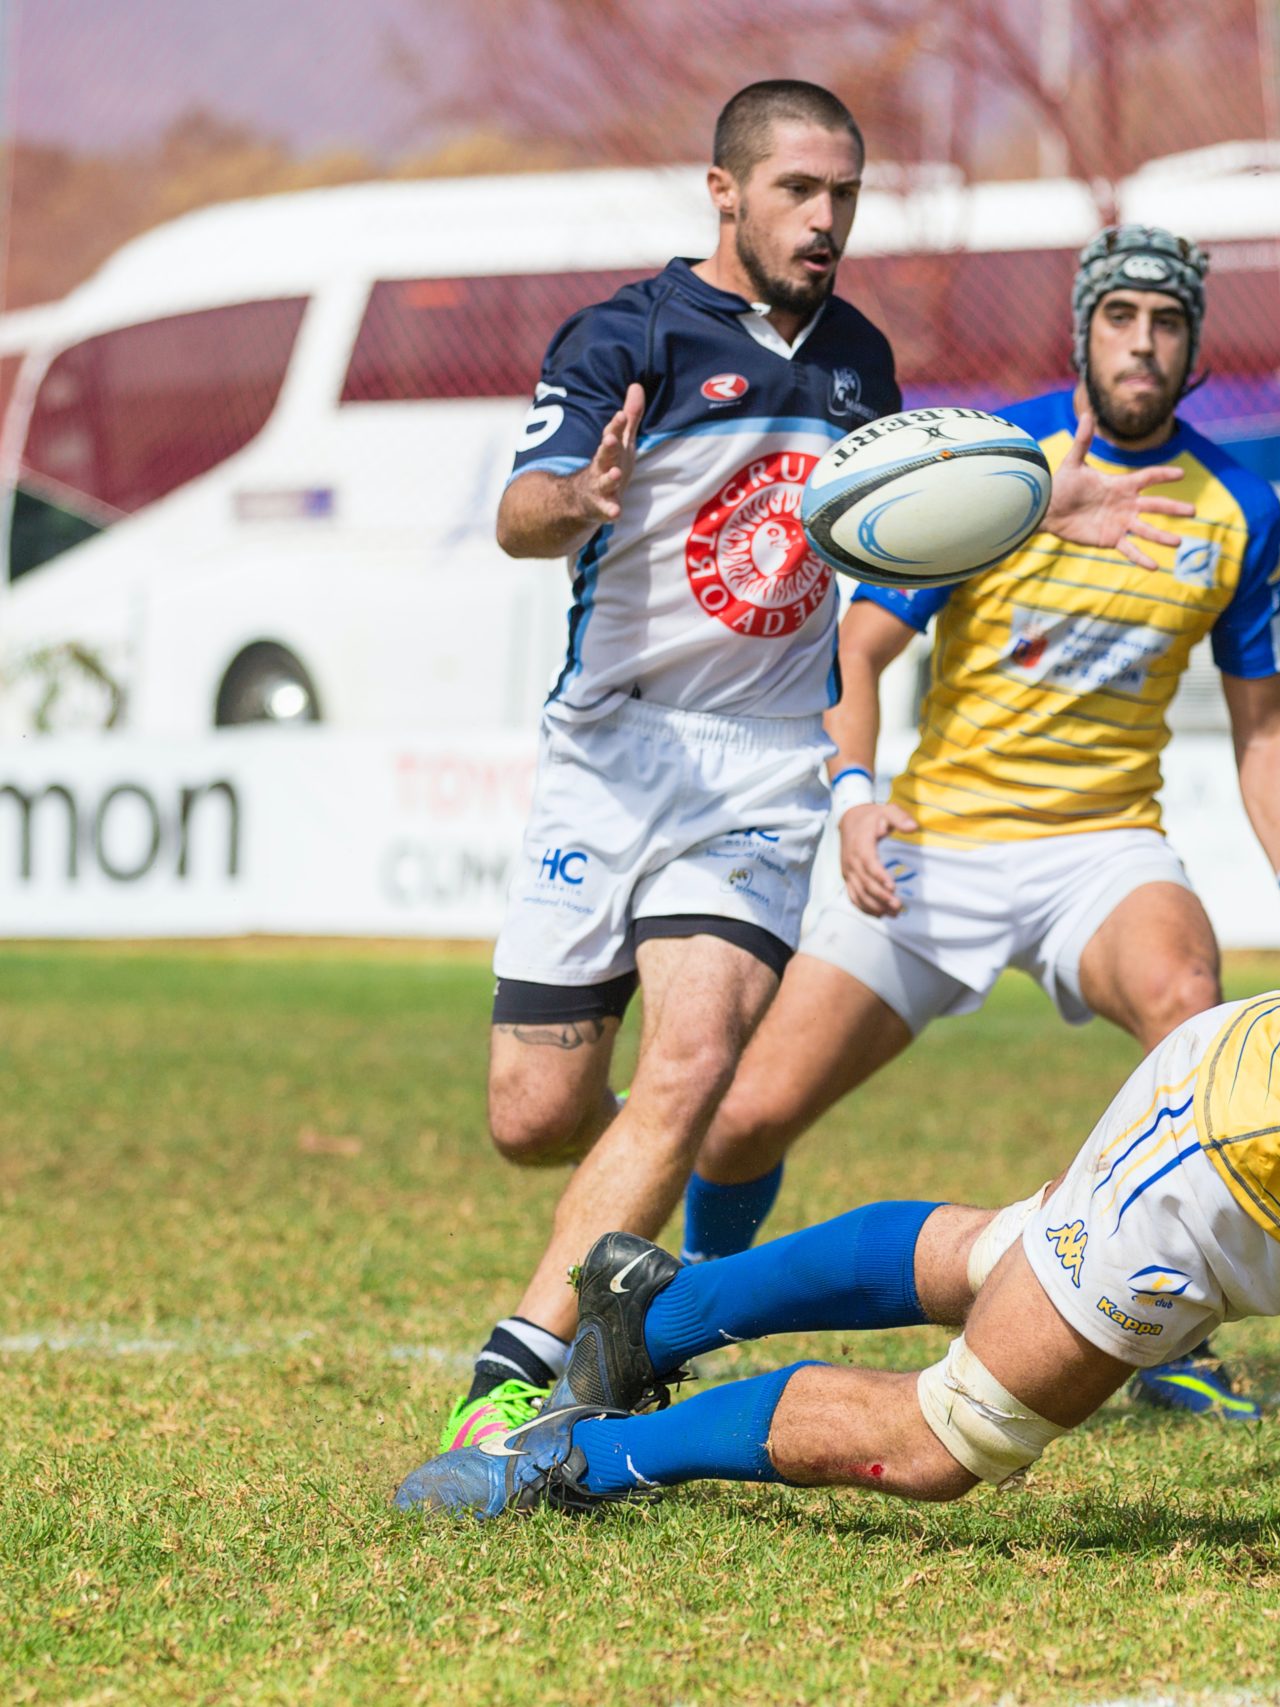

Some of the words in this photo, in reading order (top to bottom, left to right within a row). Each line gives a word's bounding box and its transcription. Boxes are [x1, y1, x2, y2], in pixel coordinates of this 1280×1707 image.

[0, 781, 242, 882] mon
[539, 848, 588, 885] HC
[1097, 1296, 1163, 1335] Kappa
